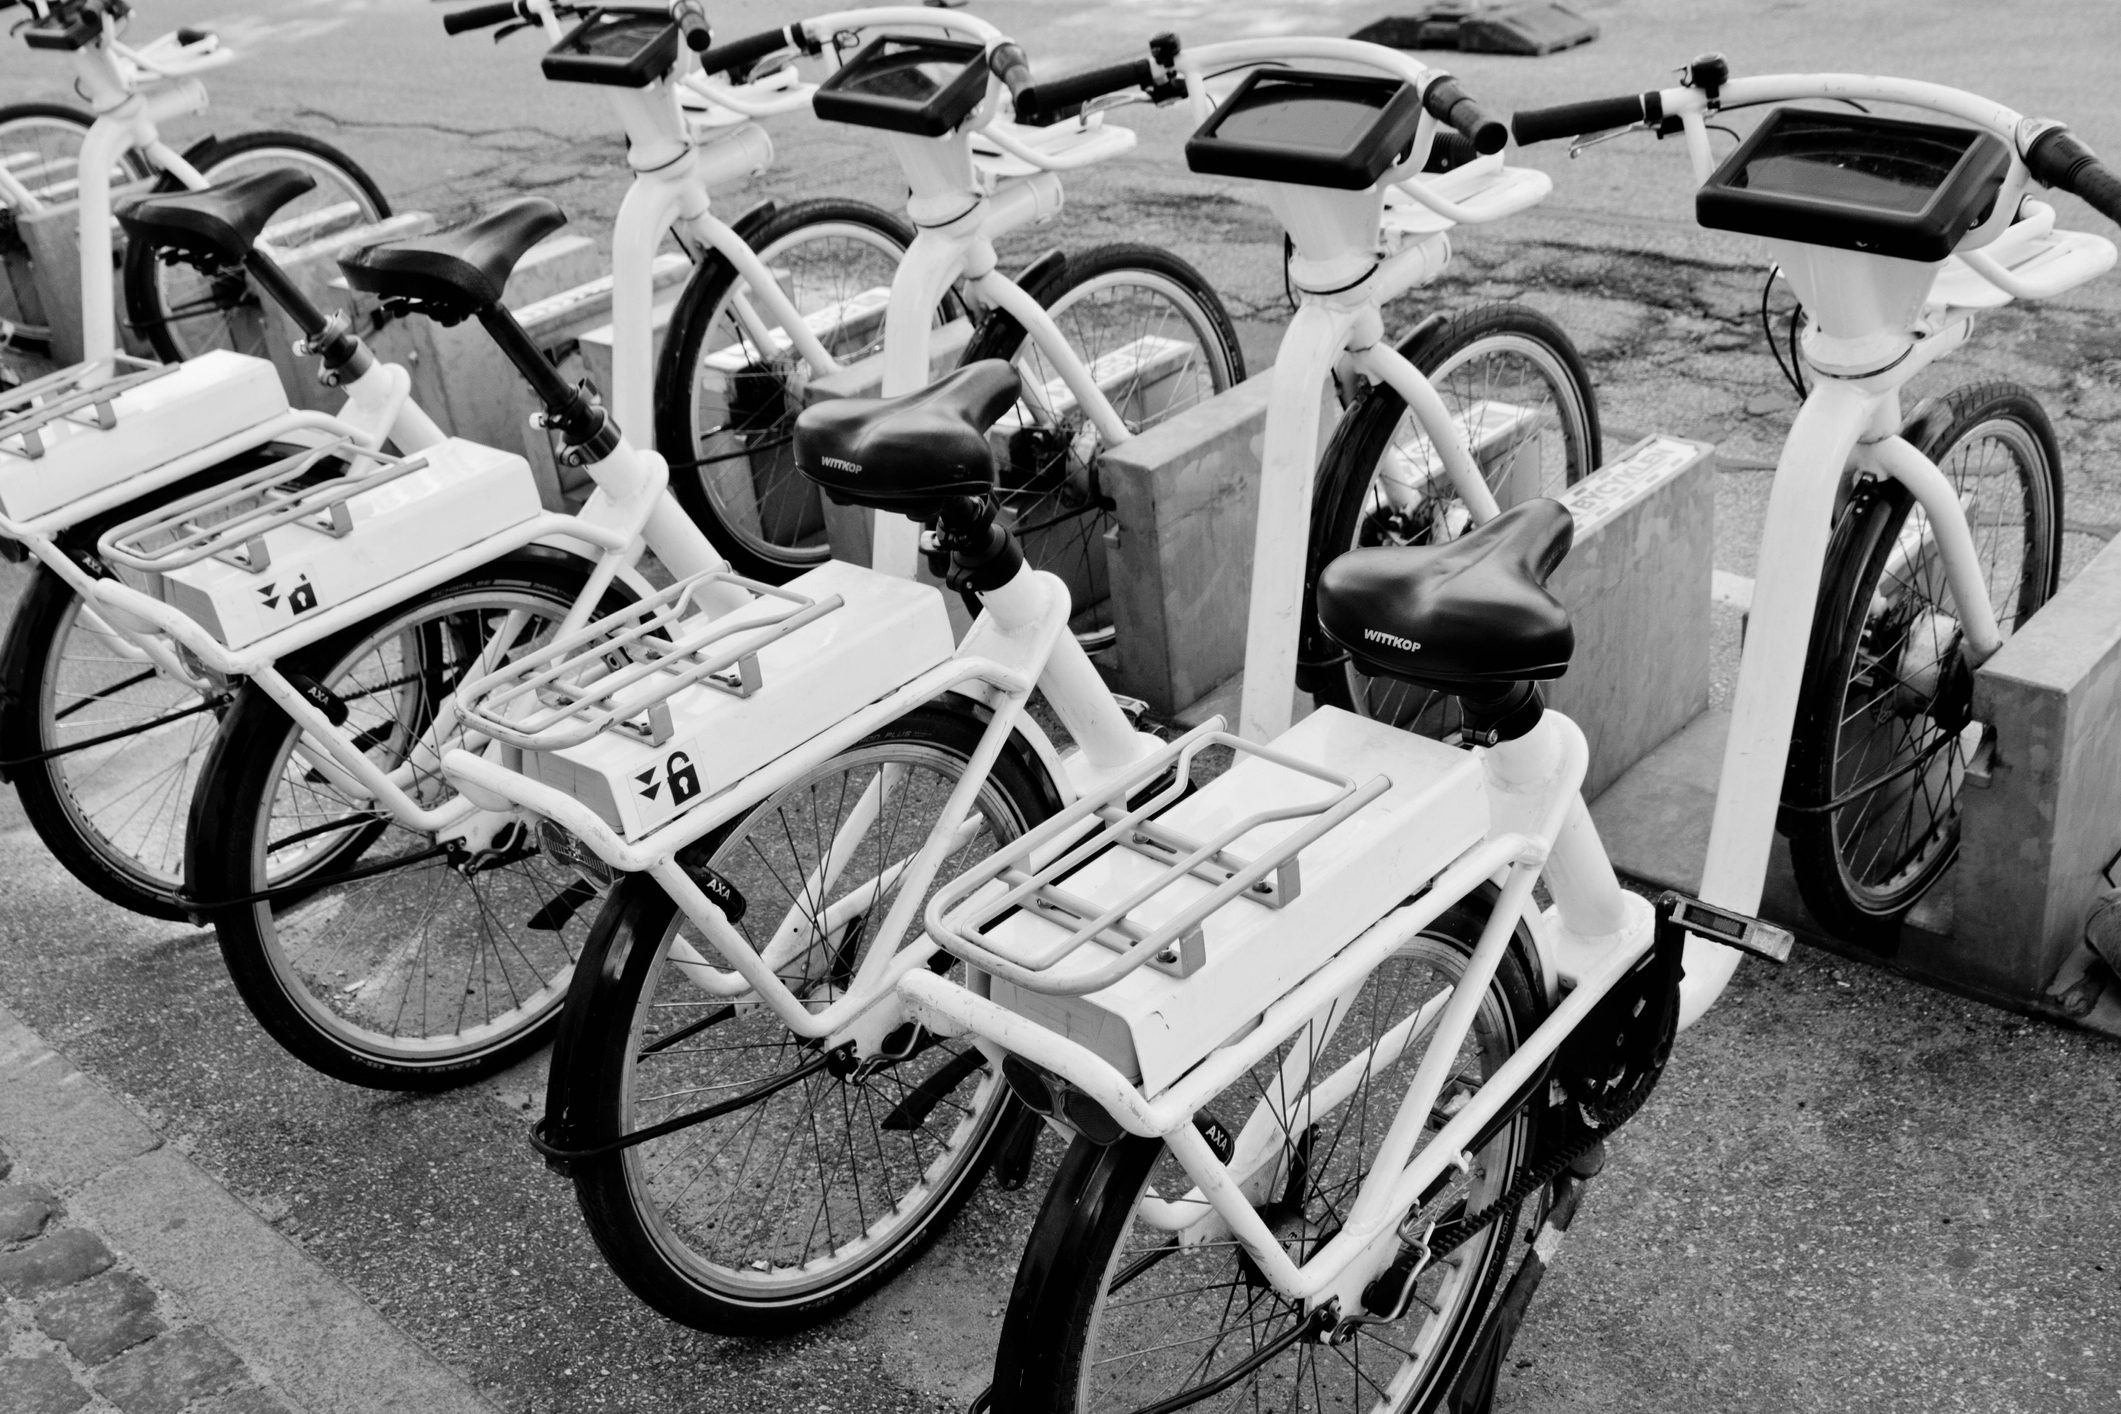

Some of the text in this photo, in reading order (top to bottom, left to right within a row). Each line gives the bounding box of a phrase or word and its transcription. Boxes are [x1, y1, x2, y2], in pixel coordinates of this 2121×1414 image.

[821, 455, 862, 474] WITTKOP
[1569, 447, 1676, 510] BYCYKLEN
[1364, 628, 1422, 653] WITTKOP
[307, 686, 329, 706] AXA
[706, 878, 731, 901] AXA
[1205, 1125, 1228, 1152] AXA
